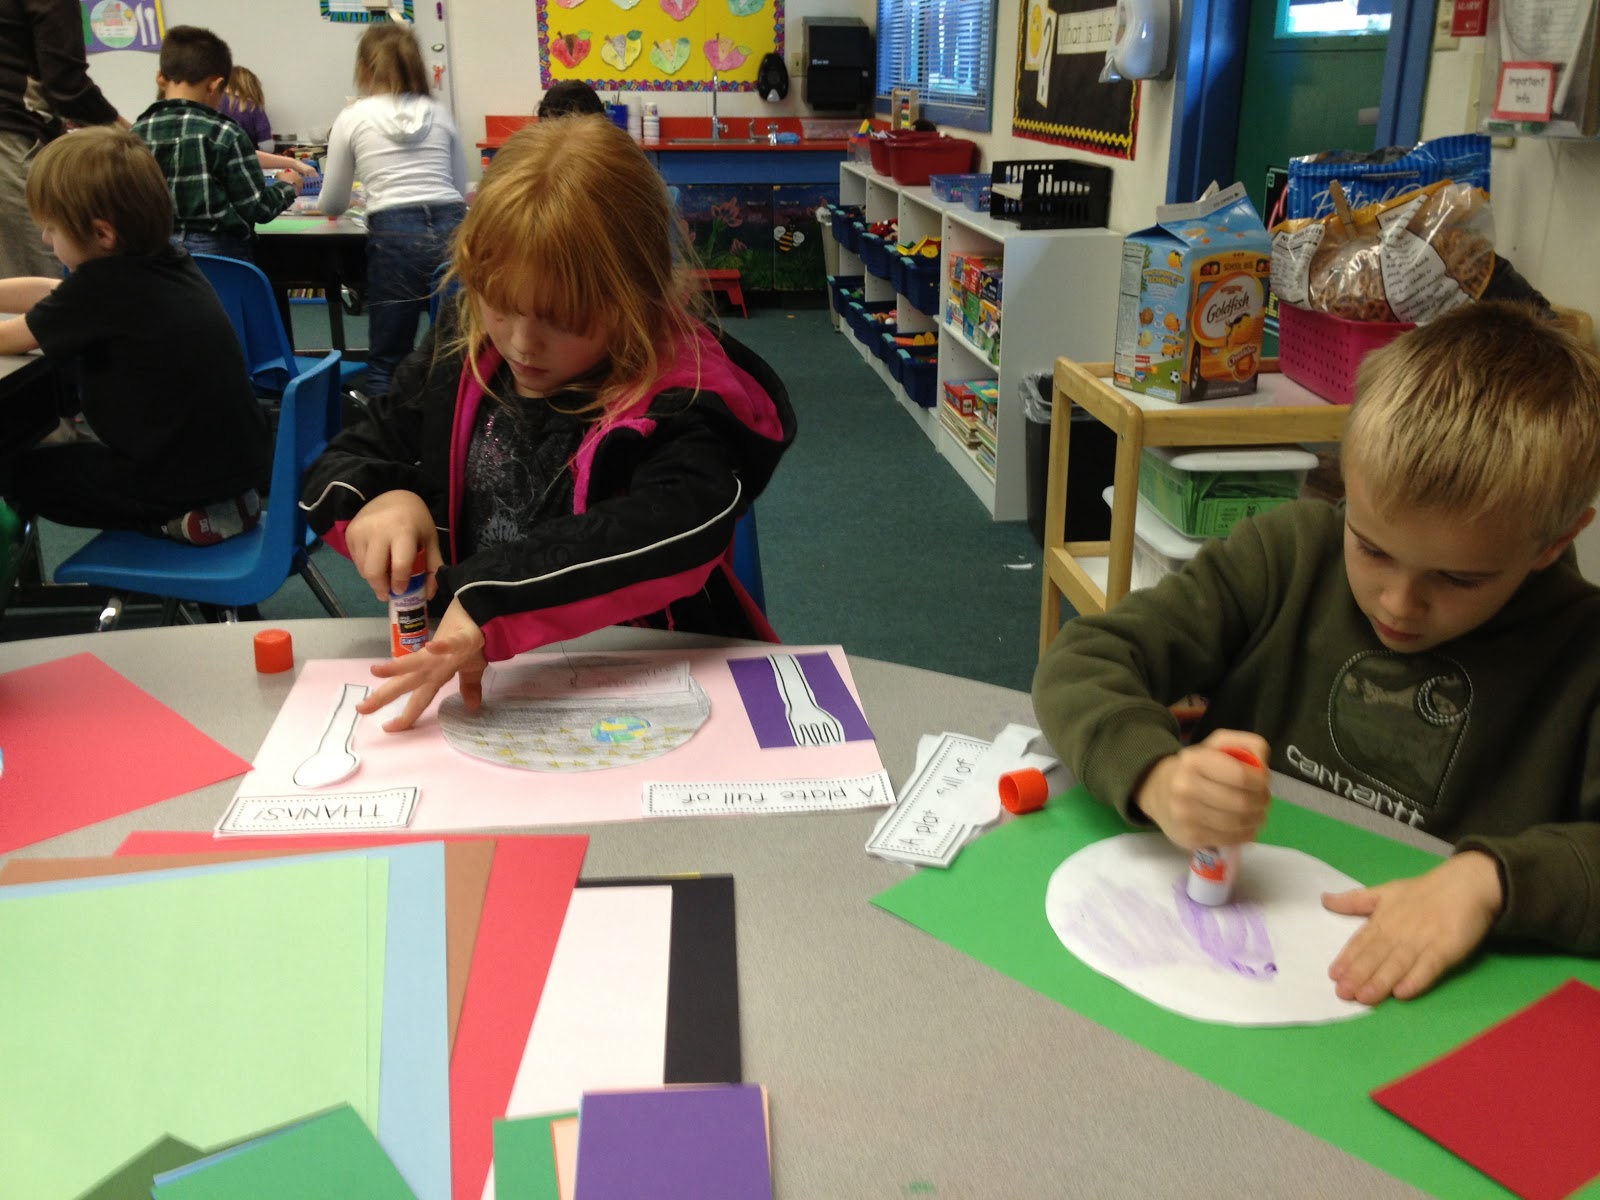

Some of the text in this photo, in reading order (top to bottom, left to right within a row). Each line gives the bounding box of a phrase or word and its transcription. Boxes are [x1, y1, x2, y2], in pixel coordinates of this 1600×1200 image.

[1206, 291, 1250, 324] Goldfish
[723, 790, 766, 807] full
[779, 786, 847, 805] plate
[858, 784, 875, 801] A
[254, 803, 385, 822] THANKS!
